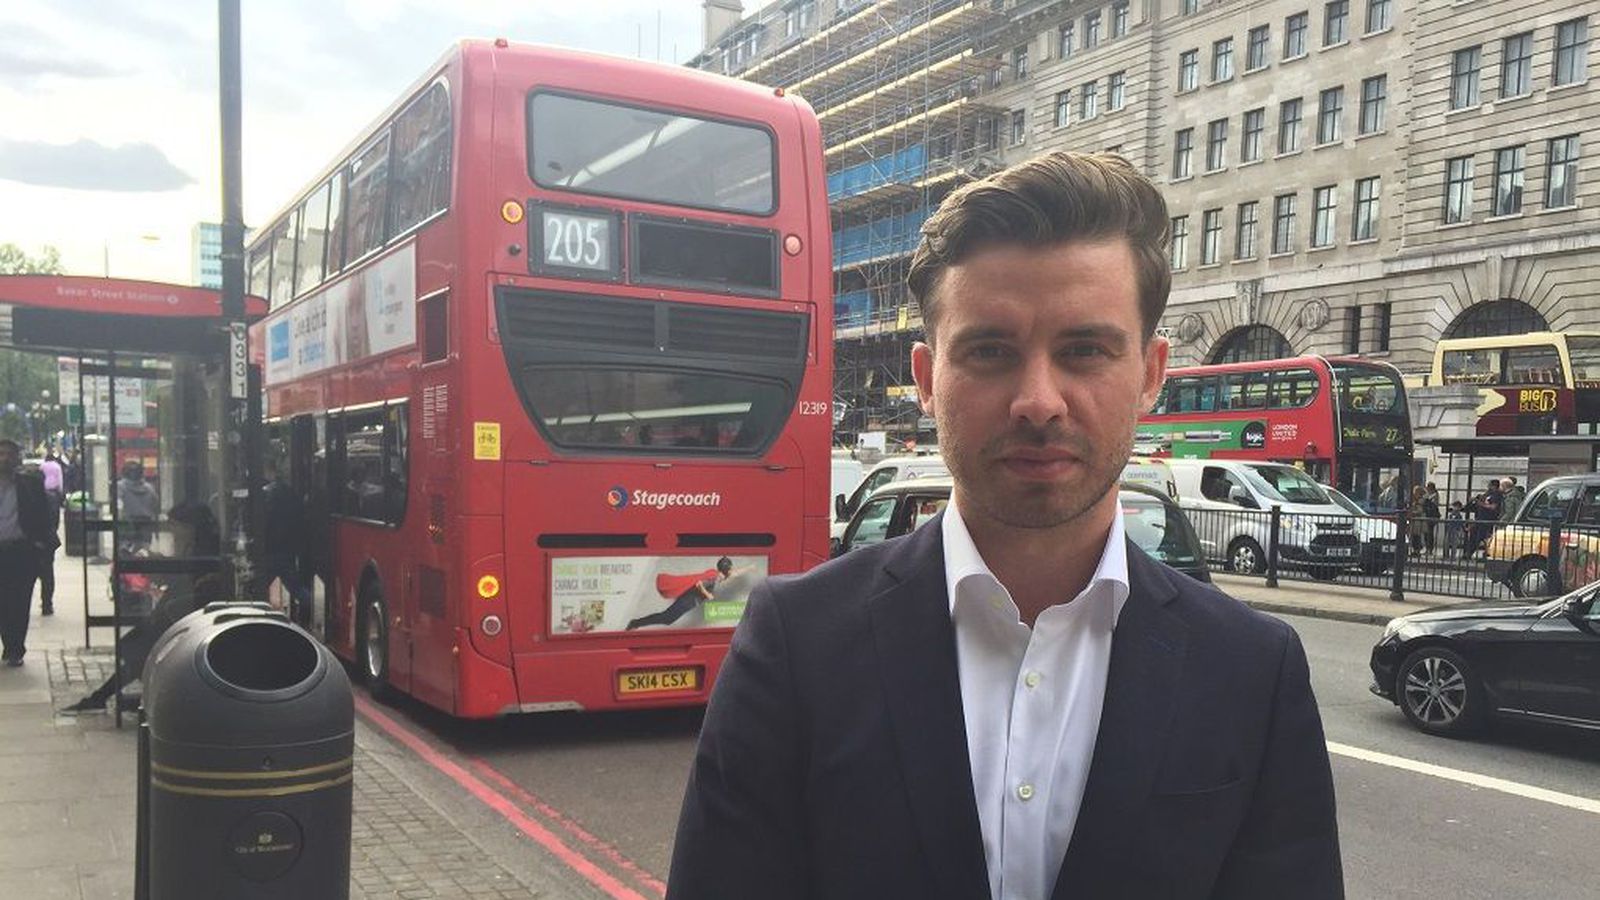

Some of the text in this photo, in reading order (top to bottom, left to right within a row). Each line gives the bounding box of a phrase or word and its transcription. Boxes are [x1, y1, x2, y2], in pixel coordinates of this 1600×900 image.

[547, 217, 601, 266] 205
[90, 287, 122, 300] Street
[126, 291, 166, 302] Station
[1520, 389, 1541, 401] BIG
[799, 401, 828, 415] 12319
[1520, 401, 1540, 412] BUS
[632, 489, 721, 509] Stagecoach
[628, 672, 688, 690] SK14 CSX
